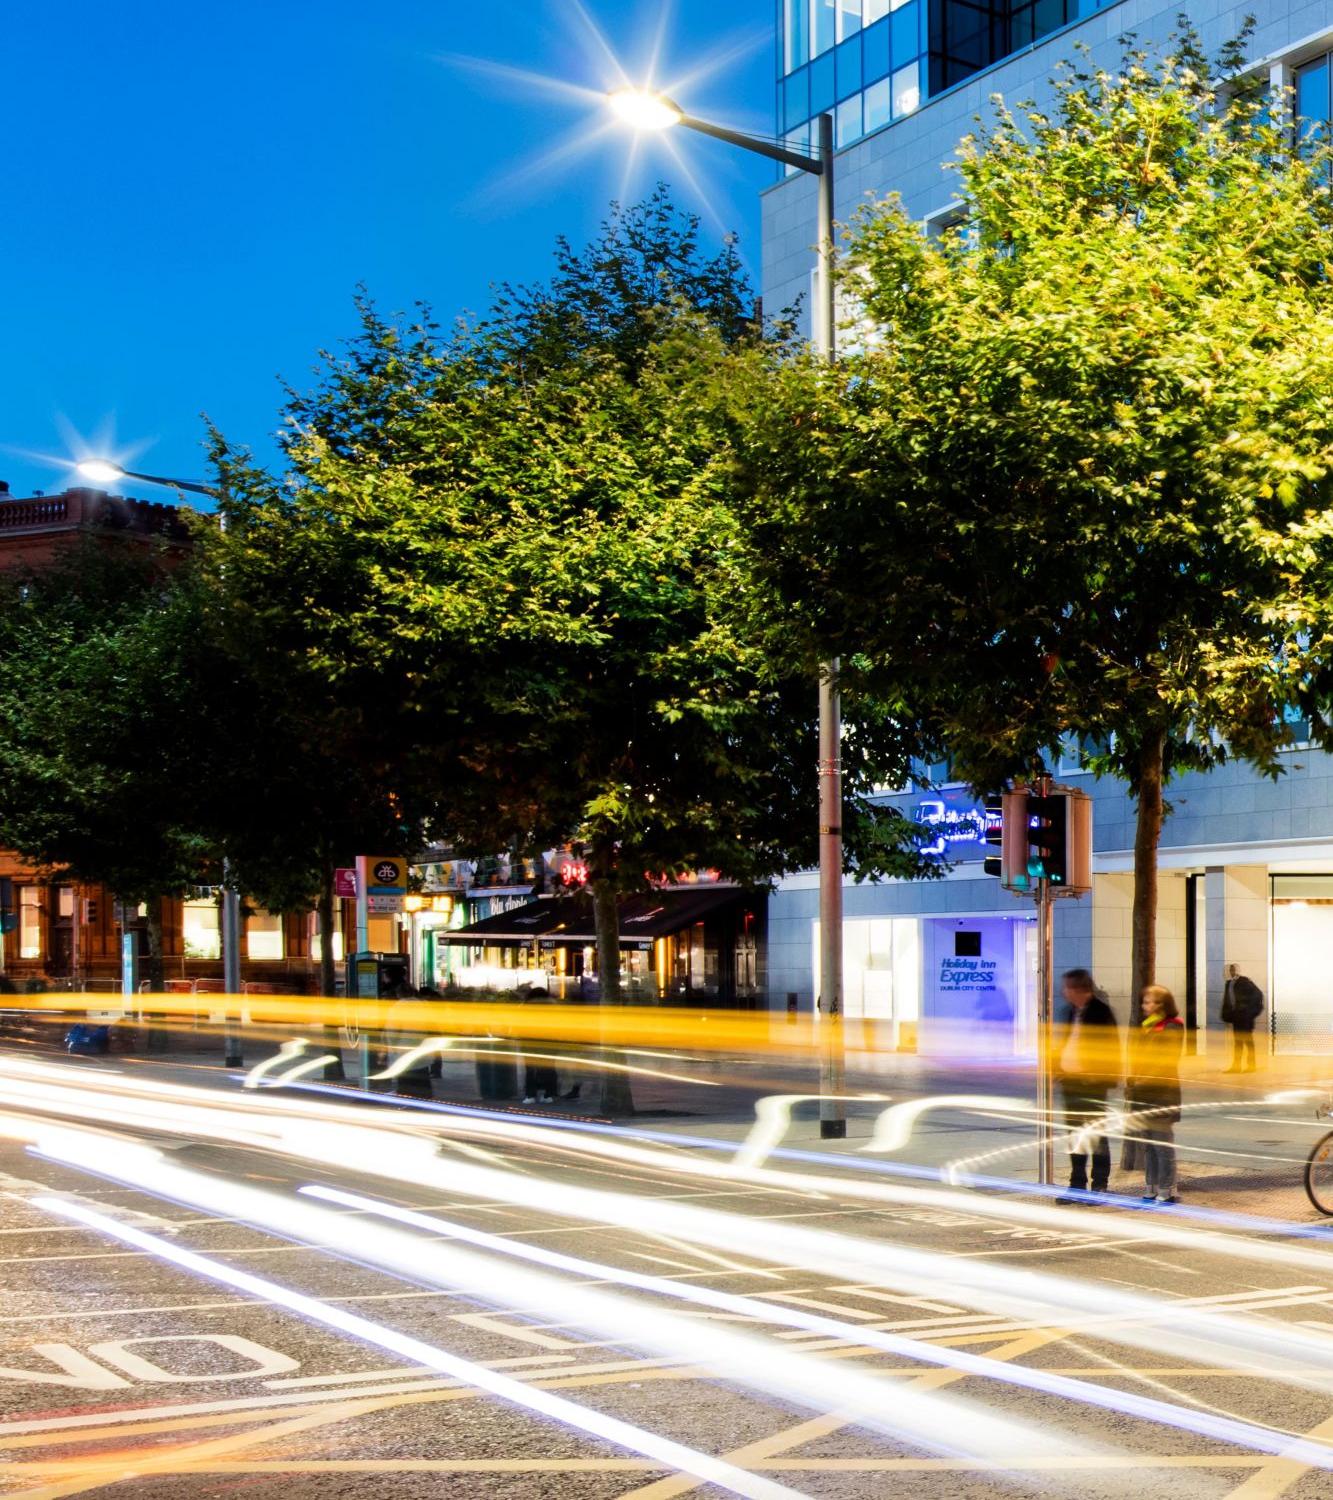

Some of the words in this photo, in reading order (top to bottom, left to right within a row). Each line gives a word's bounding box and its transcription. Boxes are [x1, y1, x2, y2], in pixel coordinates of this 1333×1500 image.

[941, 958, 978, 970] Holiday
[980, 959, 997, 969] Inn
[940, 969, 994, 985] Express
